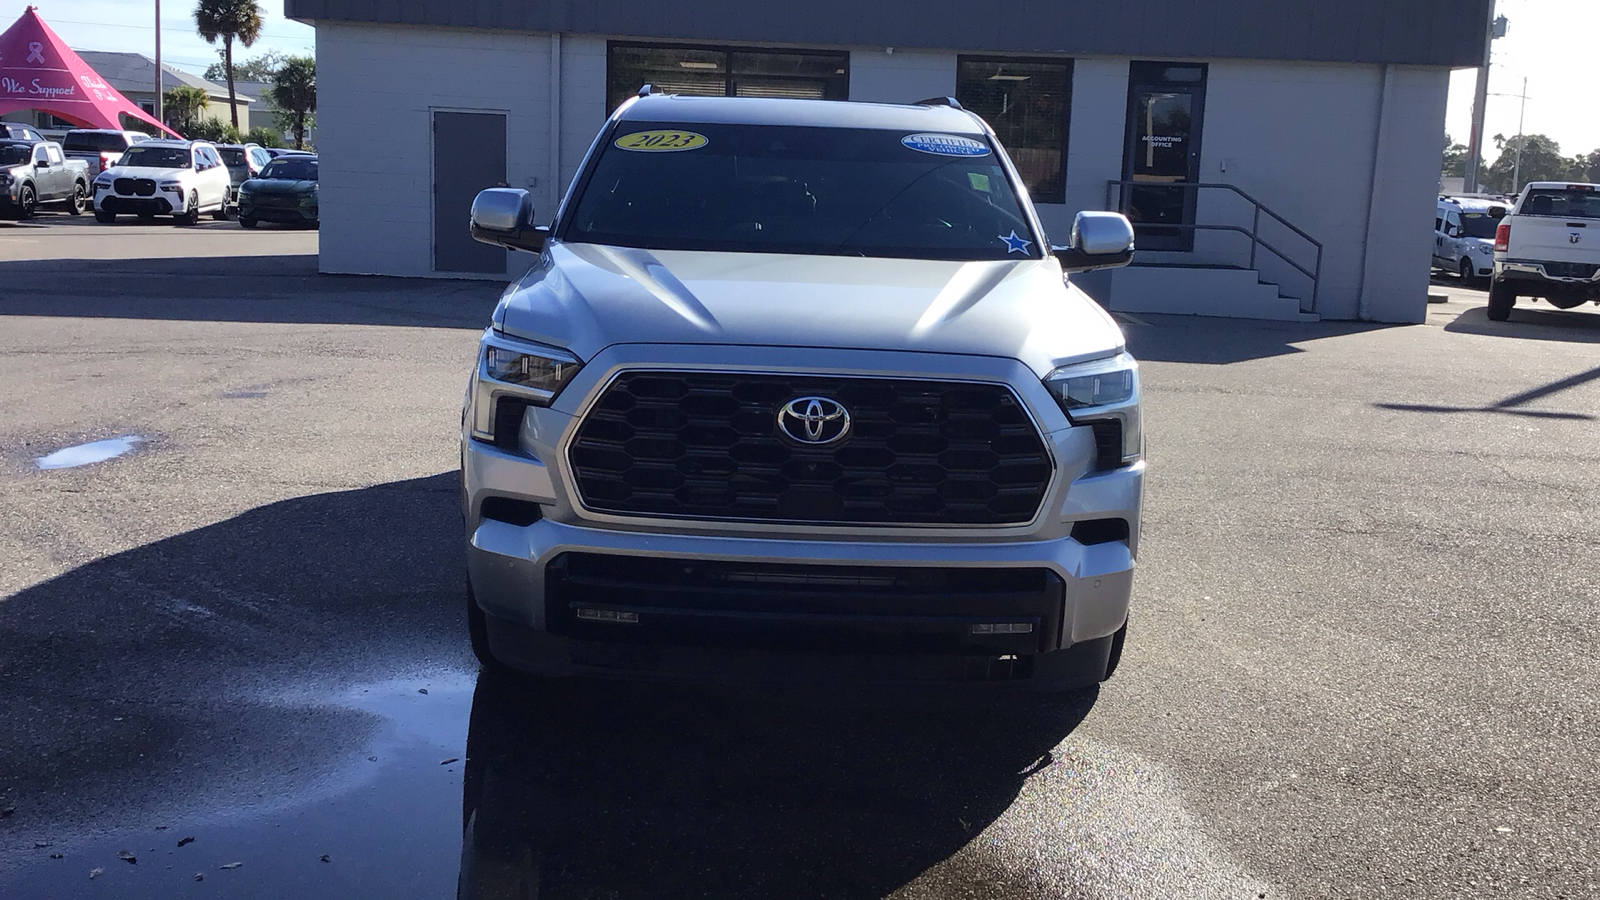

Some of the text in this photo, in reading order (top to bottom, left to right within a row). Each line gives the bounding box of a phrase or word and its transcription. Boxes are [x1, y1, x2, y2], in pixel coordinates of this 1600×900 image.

[2, 77, 75, 97] We Support
[628, 134, 696, 147] 2023
[910, 136, 981, 148] CERTIFIED
